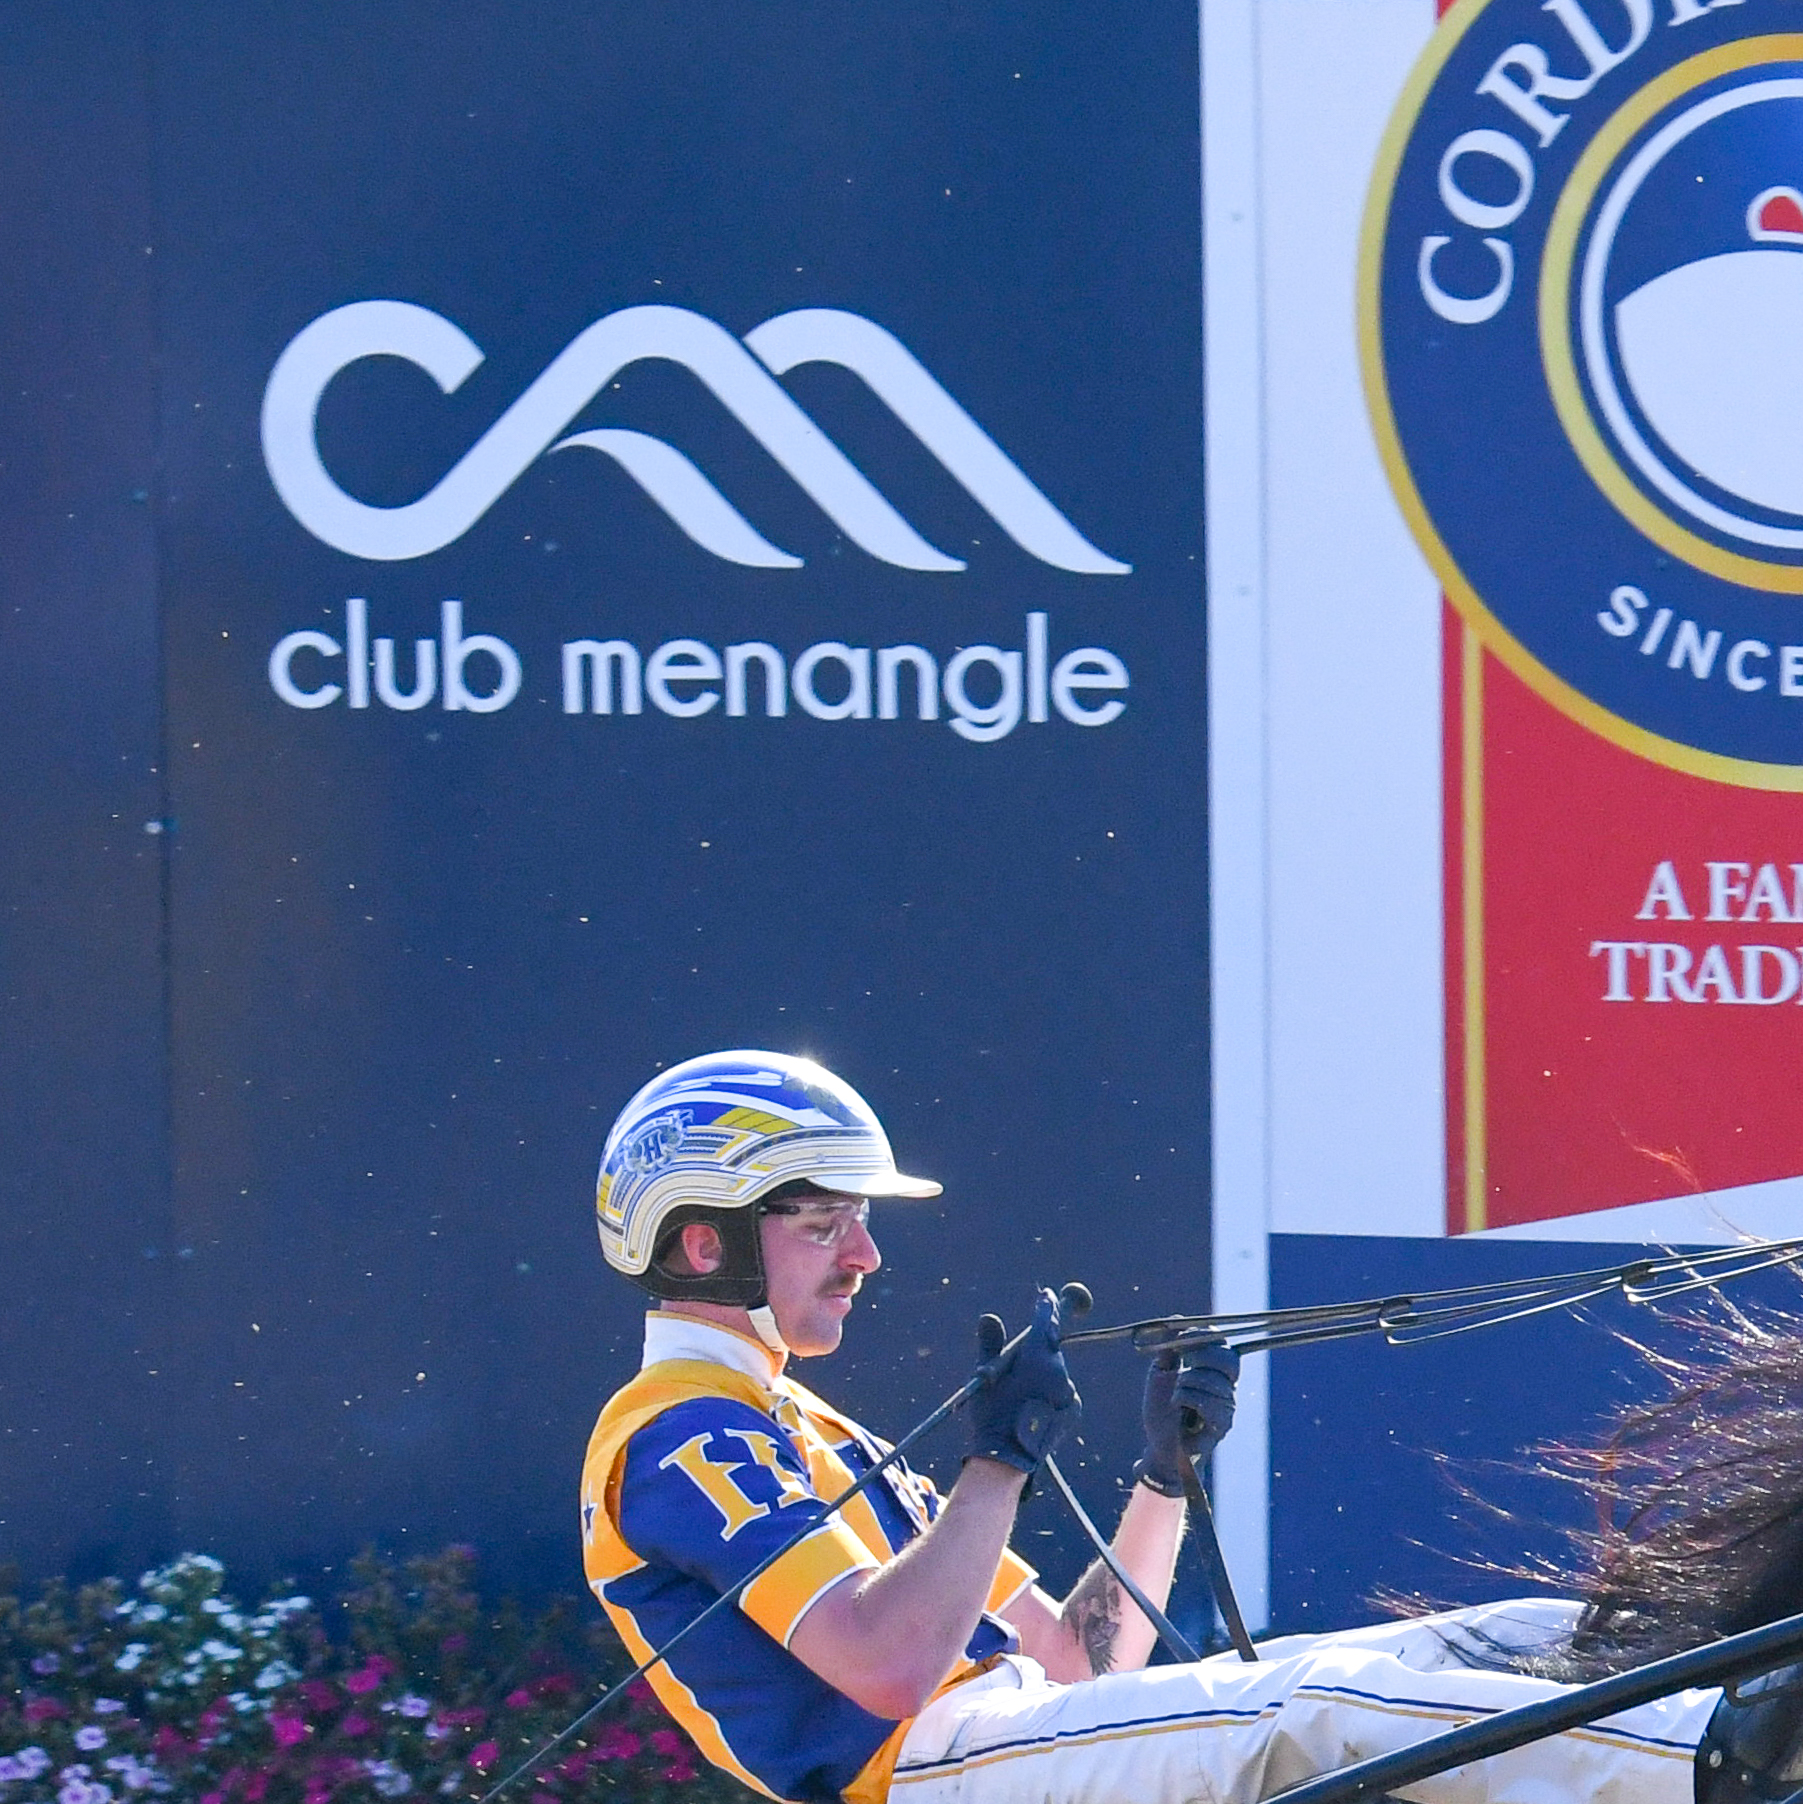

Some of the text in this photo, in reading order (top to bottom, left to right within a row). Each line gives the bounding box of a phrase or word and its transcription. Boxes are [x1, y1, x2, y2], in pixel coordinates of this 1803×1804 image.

[268, 598, 1130, 743] club menangle
[1635, 861, 1693, 921] A
